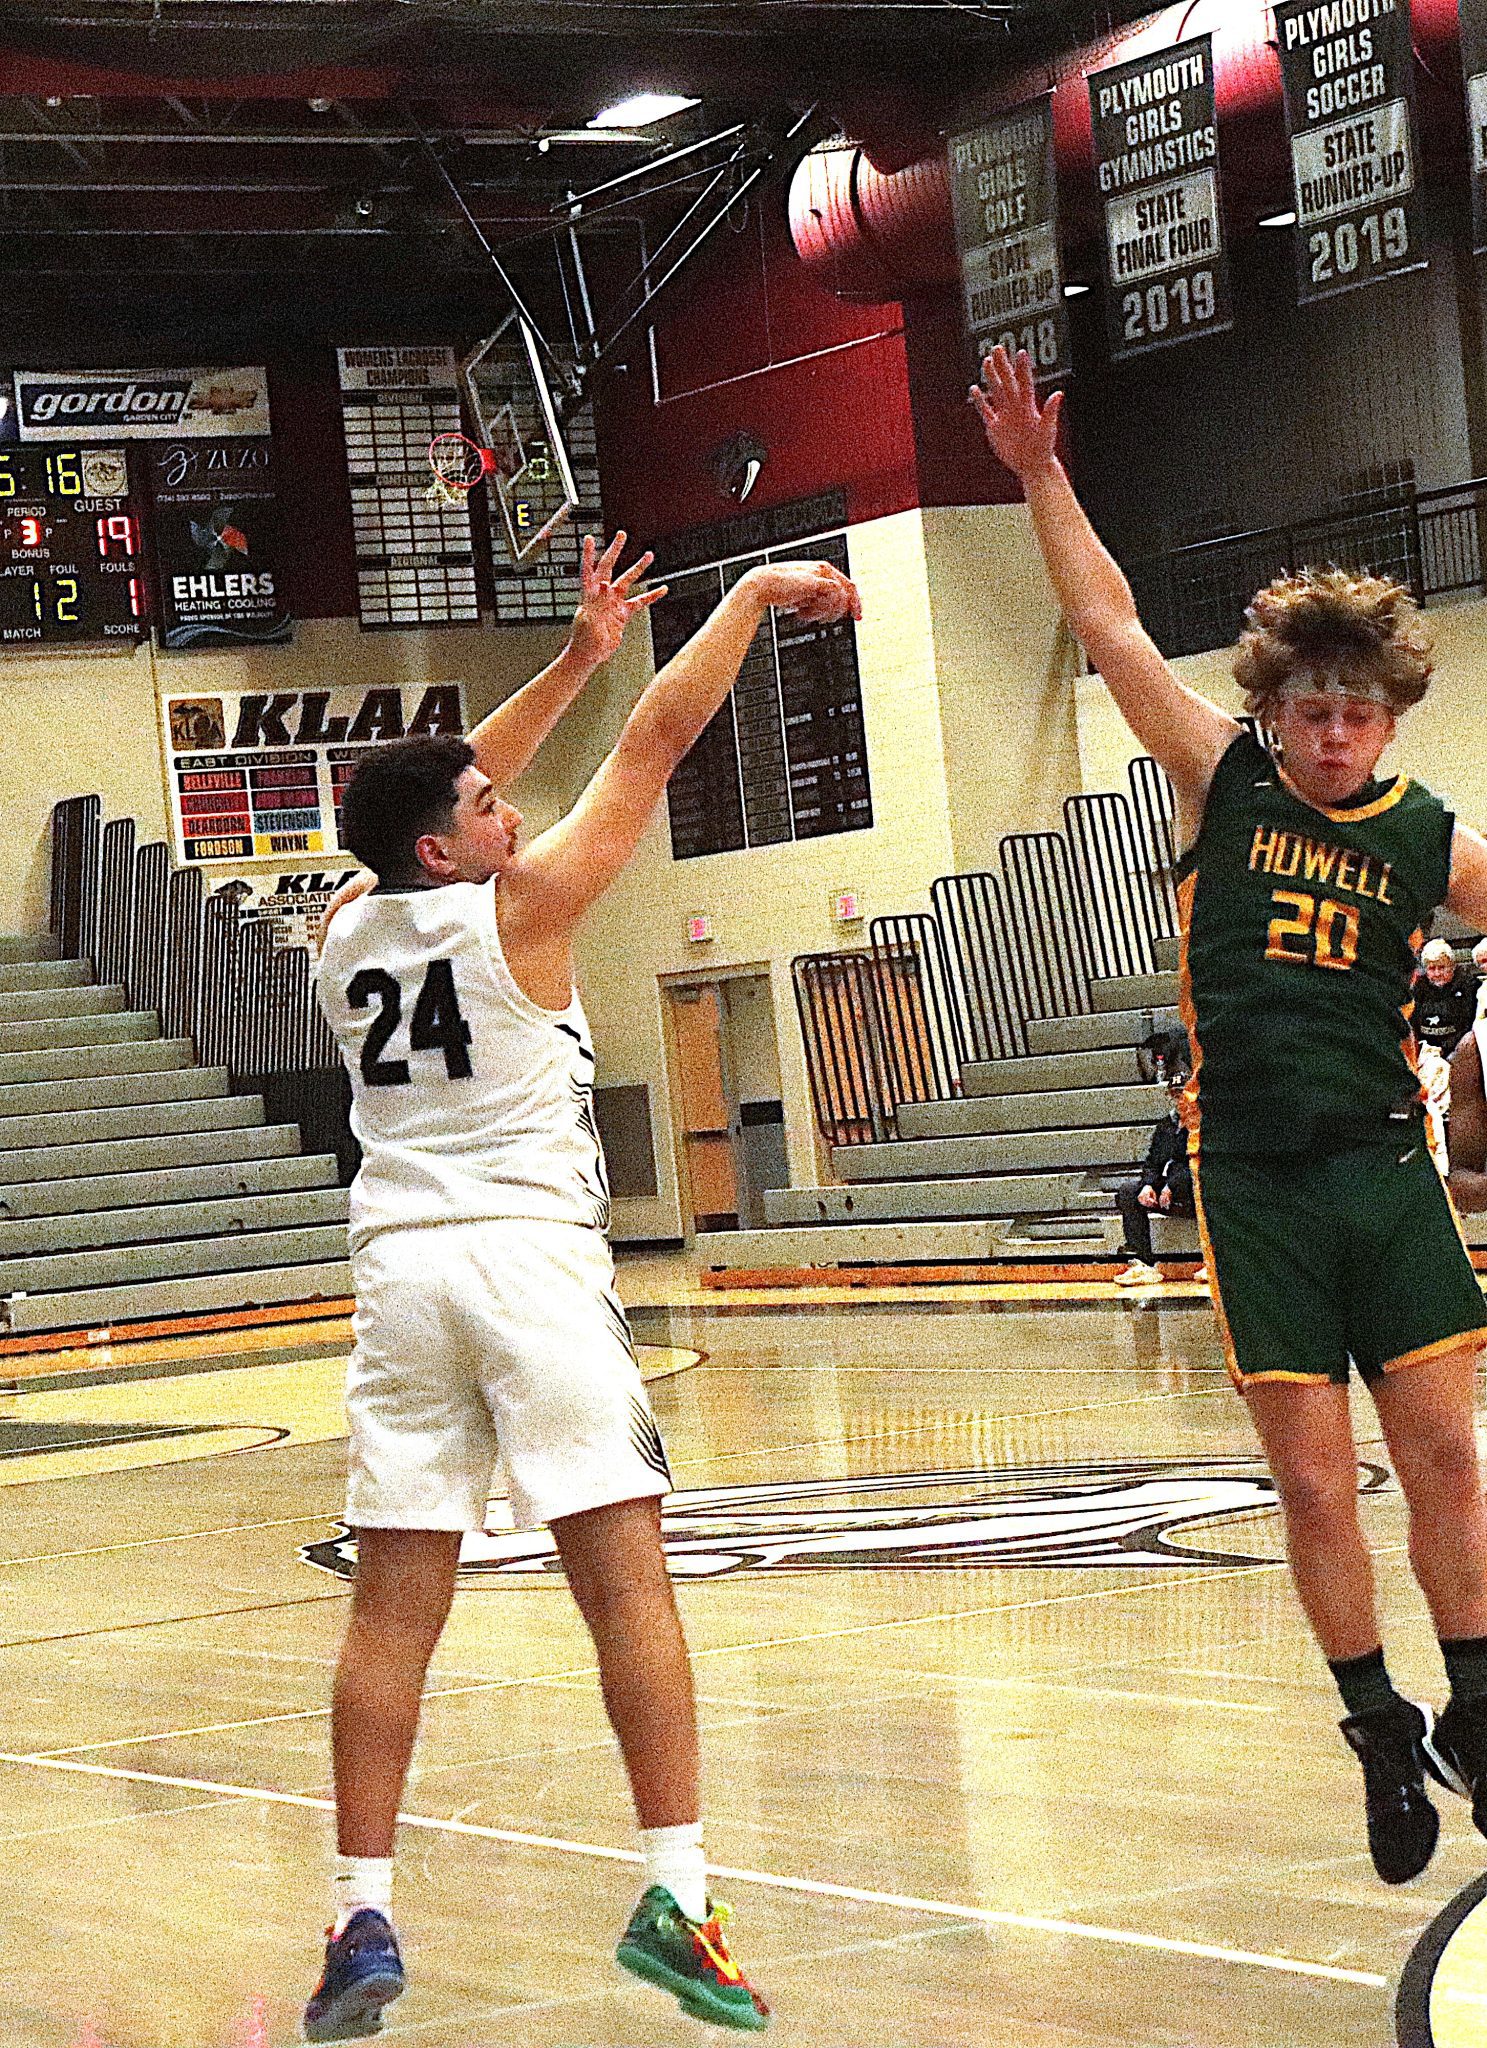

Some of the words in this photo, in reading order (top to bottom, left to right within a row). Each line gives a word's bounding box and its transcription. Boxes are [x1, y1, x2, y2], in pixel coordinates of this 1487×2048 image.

[1313, 28, 1374, 79] GIRLS
[1098, 53, 1205, 118] PLYMOUTH
[1306, 63, 1386, 121] SOCCER
[1125, 99, 1182, 147] GIRLS
[1098, 126, 1216, 192] GYMNASTICS
[1323, 120, 1376, 169] STATE
[977, 157, 1027, 200] GIRLS
[1300, 151, 1405, 215] RUNNER-UP
[985, 193, 1027, 233] GOLF
[1135, 188, 1186, 232] STATE
[1116, 227, 1165, 277] FINAL
[1168, 217, 1212, 260] FOUR
[1308, 206, 1409, 283] 2019
[1122, 270, 1216, 341] 2019
[30, 385, 185, 420] gordon
[7, 507, 47, 517] PERIOD
[74, 498, 122, 512] GUEST
[20, 518, 38, 545] 3
[97, 516, 135, 556] 19
[11, 549, 50, 559] BONUS
[49, 564, 79, 574] FOUL
[100, 562, 135, 573] FOULS
[172, 572, 275, 599] EHLERS
[174, 600, 221, 611] HEATING
[227, 598, 277, 609] COOLING
[3, 627, 42, 639] MATCH
[104, 623, 140, 634] SCORE
[231, 686, 464, 748] KLAA
[180, 756, 228, 769] EAST
[235, 751, 313, 766] DIVISION
[255, 810, 320, 830] STEVENSON
[194, 839, 244, 857] FORDSON
[270, 834, 309, 852] WAYNE
[1249, 824, 1393, 905] HOWELL
[1264, 888, 1360, 970] 20
[345, 958, 473, 1087] 24
